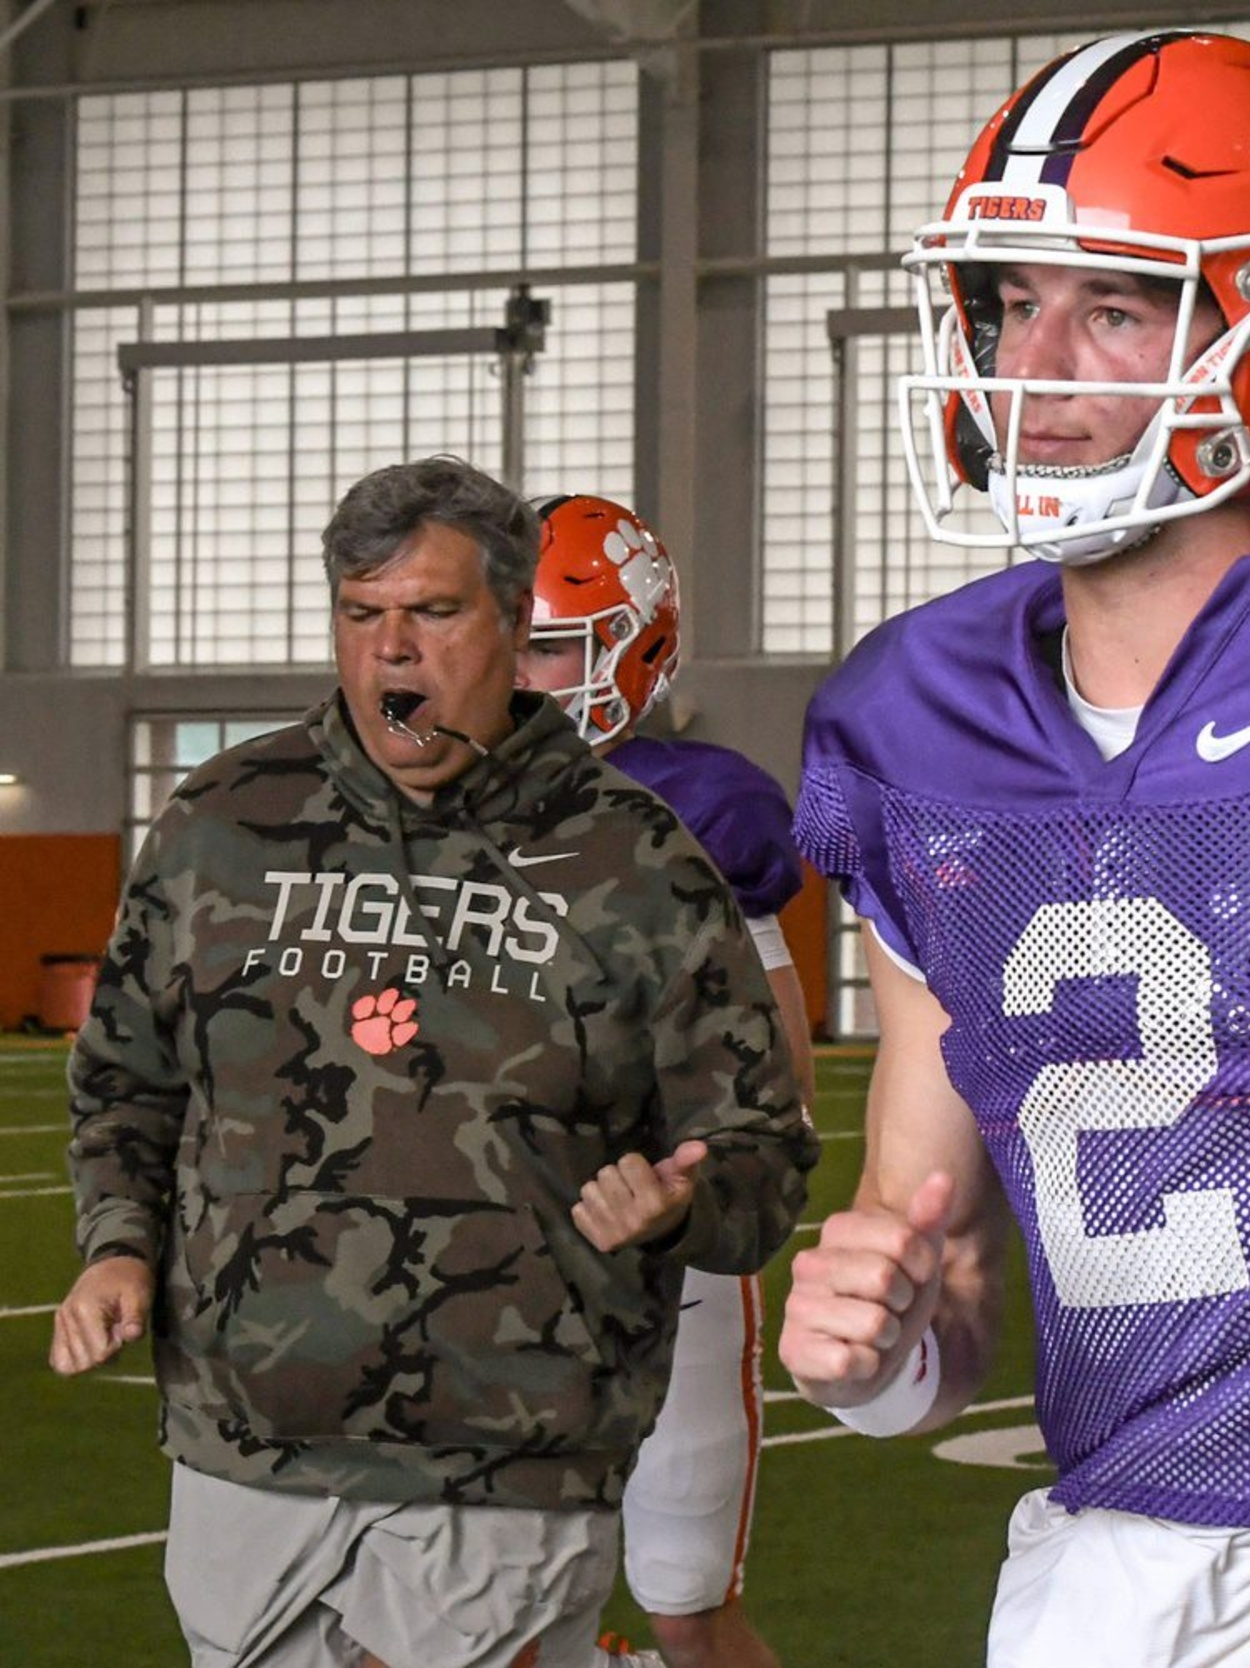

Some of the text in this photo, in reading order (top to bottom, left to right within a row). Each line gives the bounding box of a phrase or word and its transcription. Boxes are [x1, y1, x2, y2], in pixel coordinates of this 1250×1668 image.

[968, 196, 1047, 222] TIGERS
[1039, 496, 1060, 517] IN
[264, 871, 568, 965] TIGERS
[242, 947, 546, 1002] FOOTBALL
[1002, 897, 1250, 1308] 2
